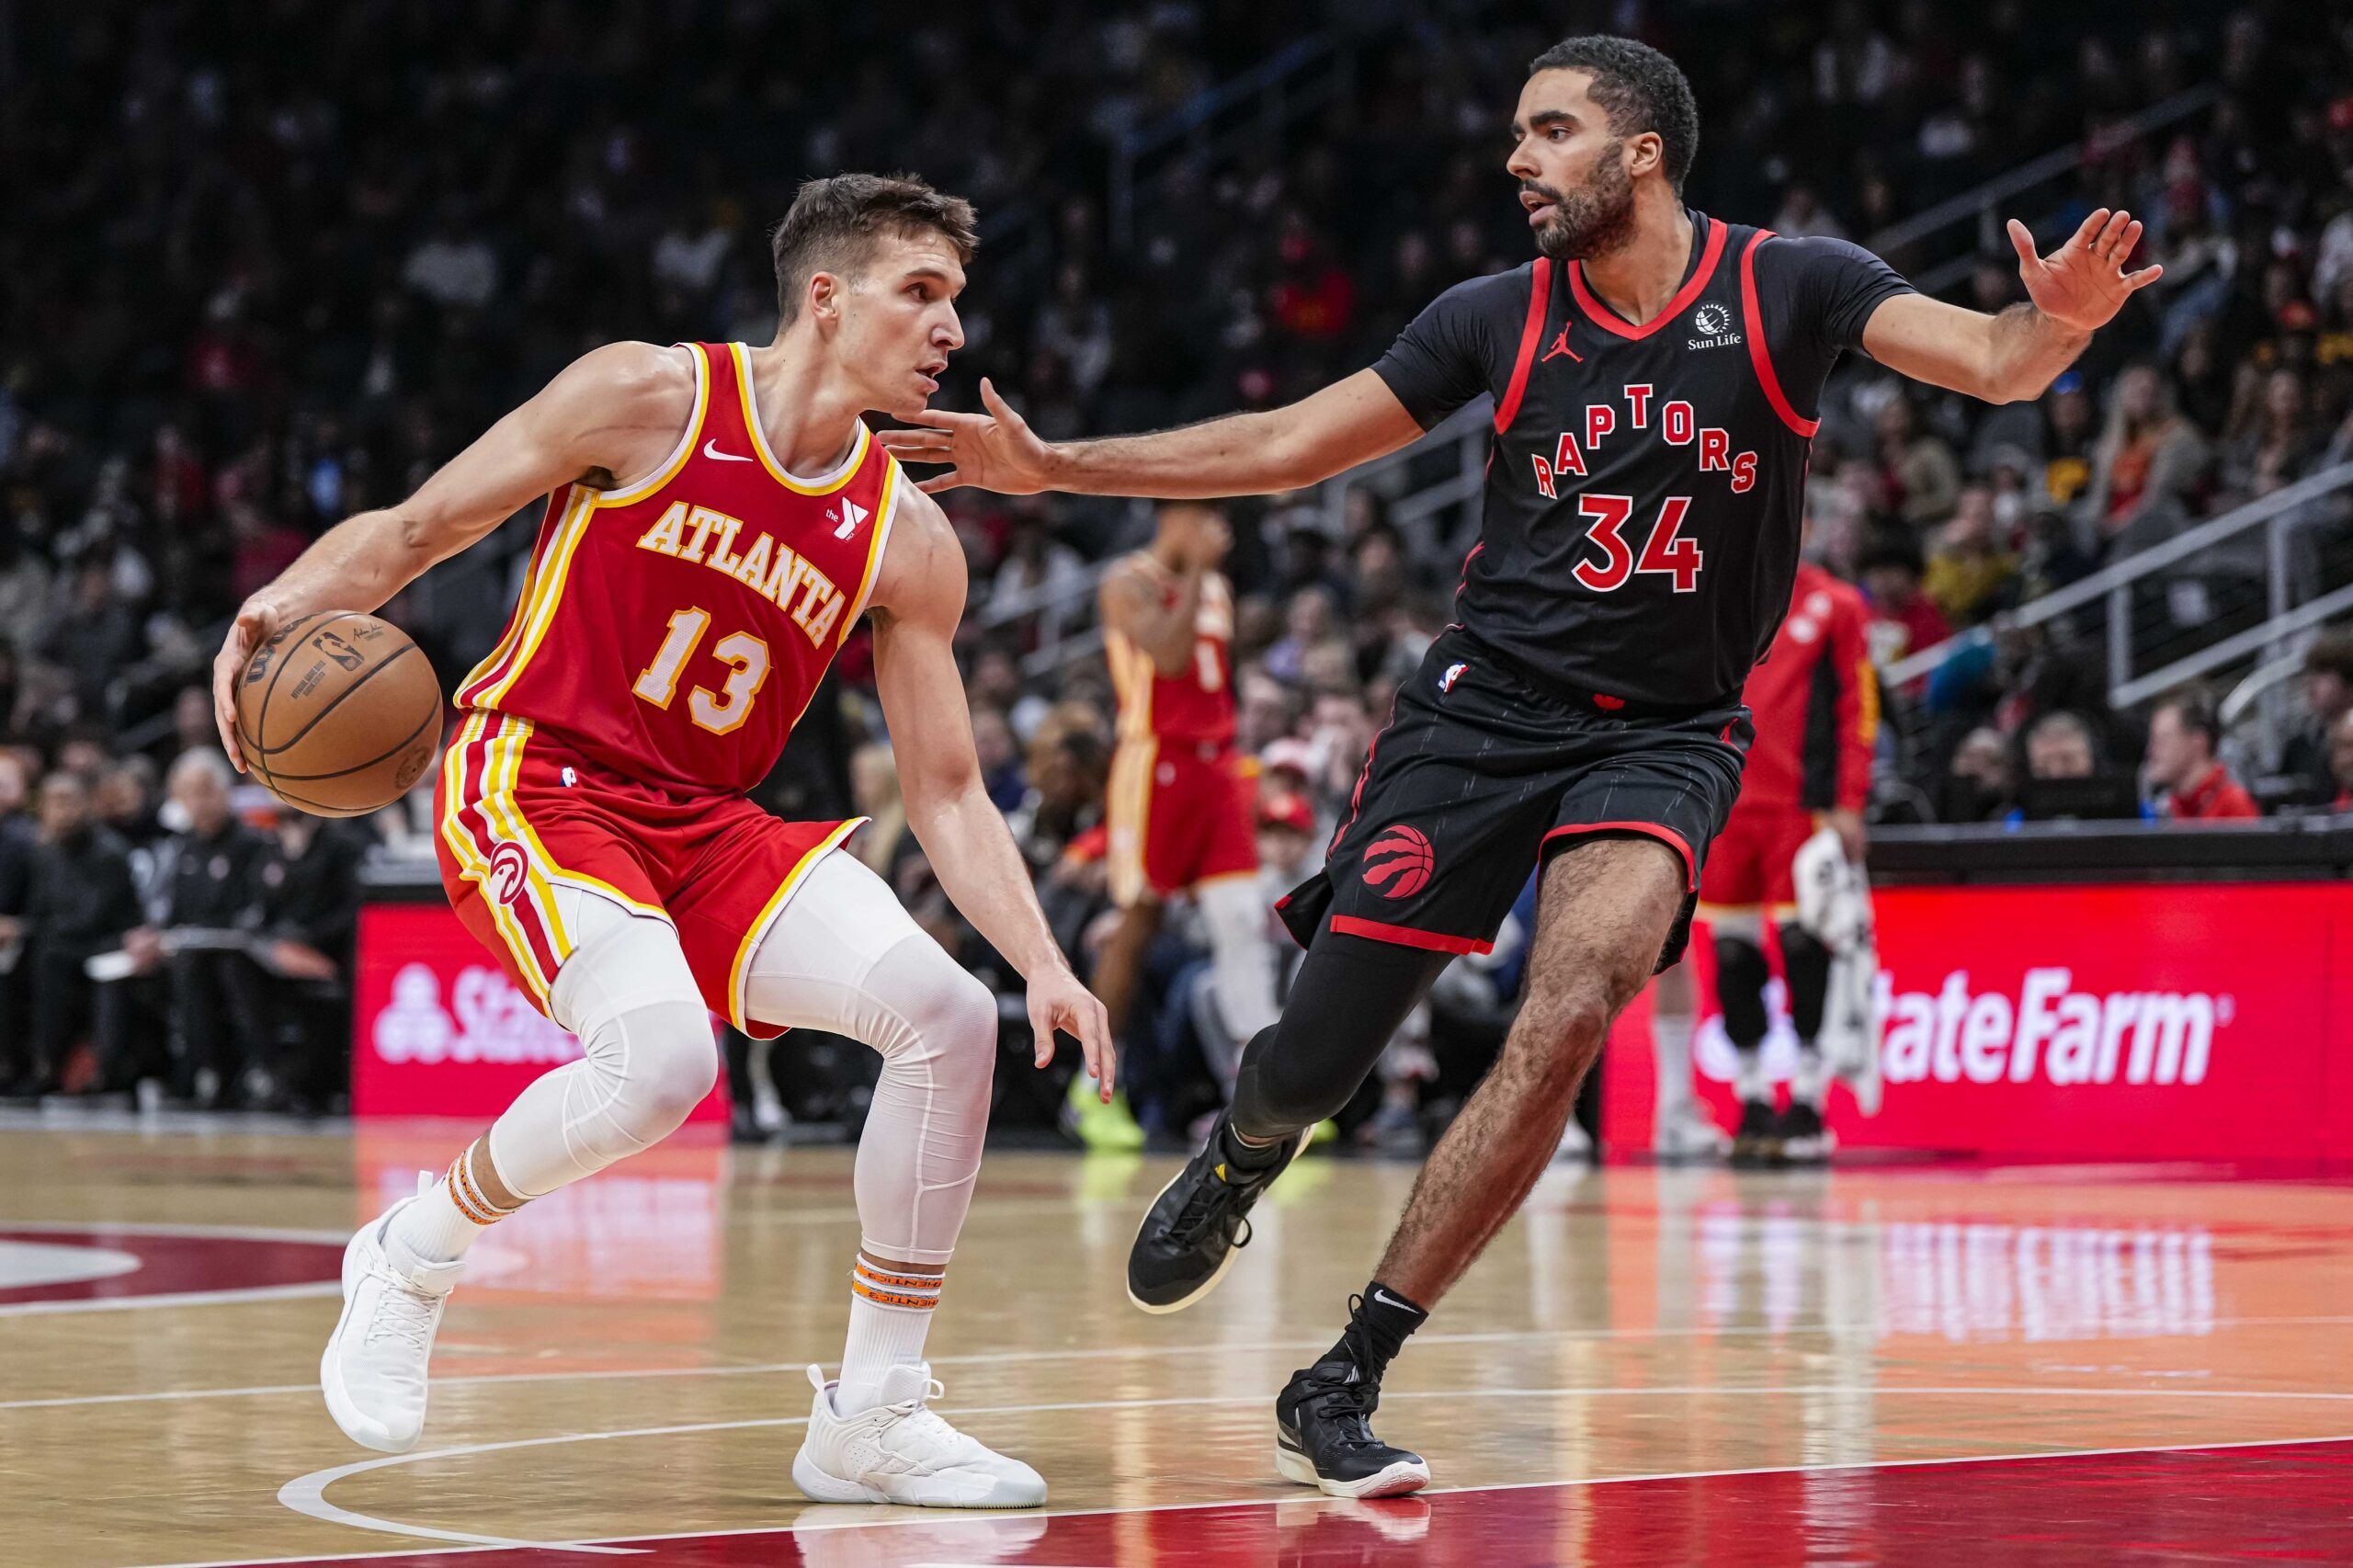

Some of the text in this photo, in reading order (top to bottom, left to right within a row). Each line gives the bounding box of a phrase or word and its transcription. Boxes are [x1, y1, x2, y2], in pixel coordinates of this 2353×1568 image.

[1688, 333, 1742, 350] Sun Life
[1531, 383, 1757, 499] RAPTORS
[825, 508, 839, 523] the
[1571, 493, 1703, 593] 34
[635, 500, 846, 650] ATLANTA
[631, 605, 771, 736] 13
[1873, 967, 2213, 1085] ateFarm
